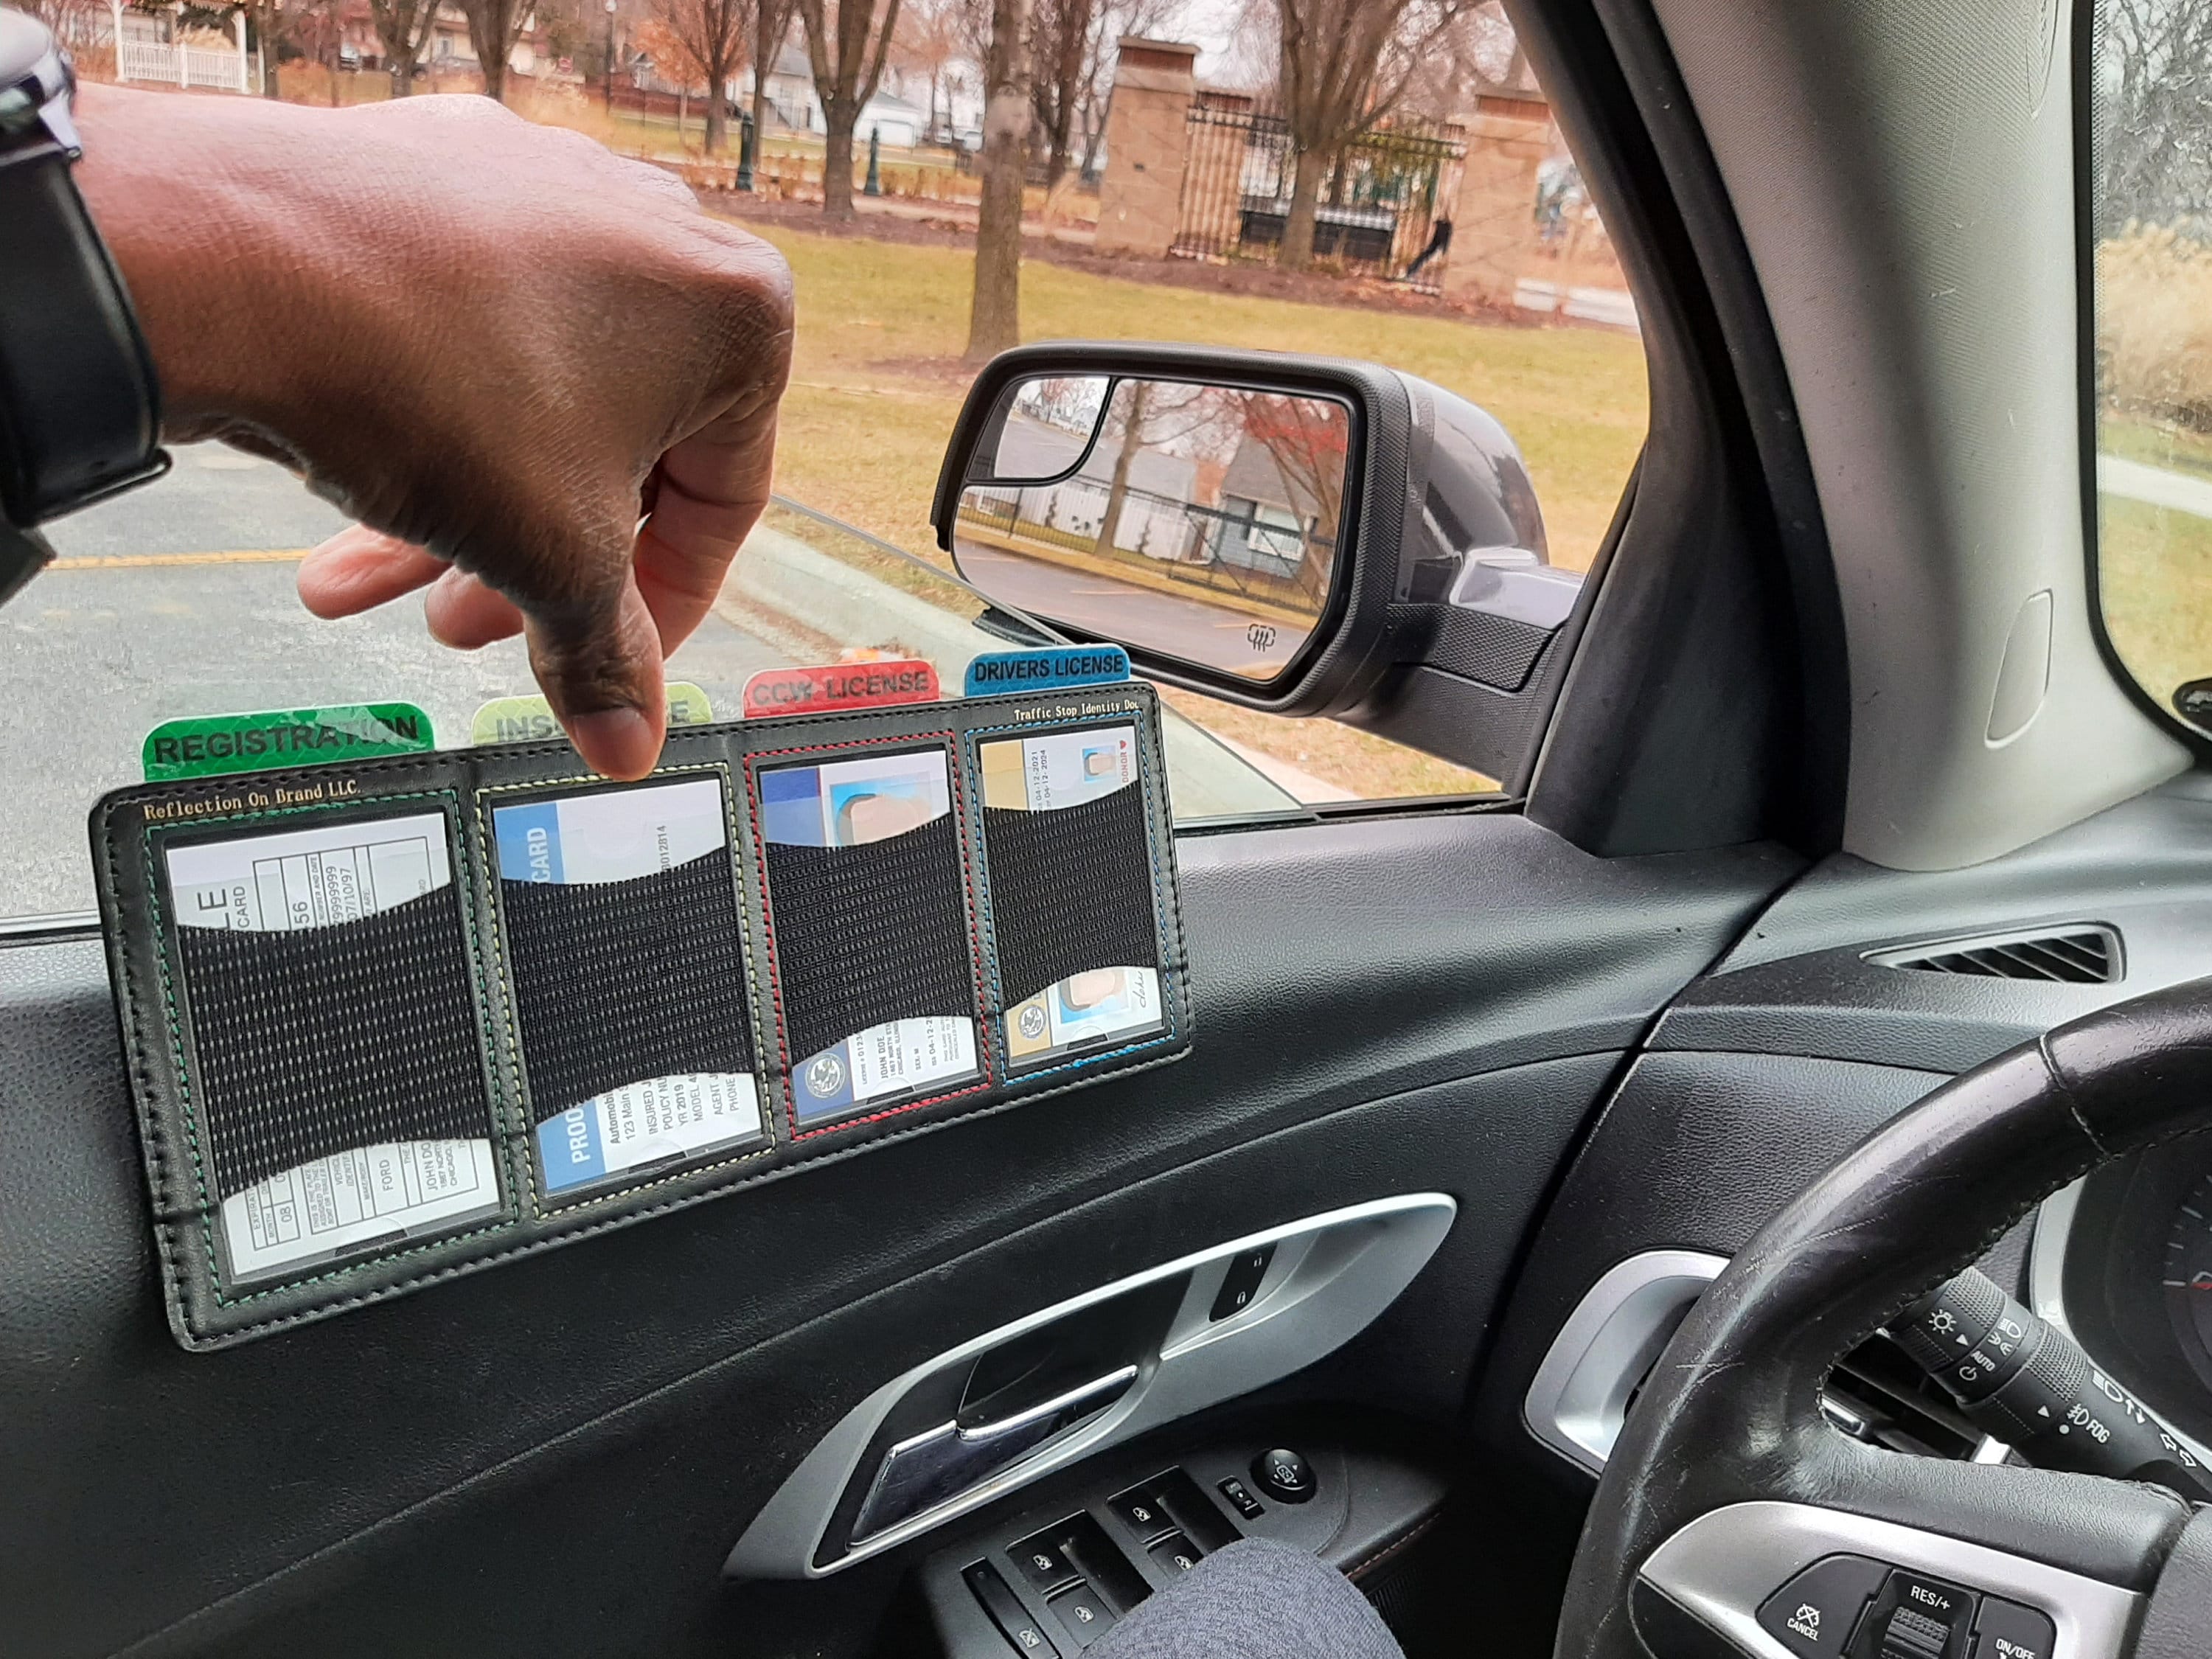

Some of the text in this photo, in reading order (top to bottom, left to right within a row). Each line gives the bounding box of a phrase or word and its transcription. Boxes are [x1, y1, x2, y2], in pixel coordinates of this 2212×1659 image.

[975, 654, 1124, 682] DRIVERS LICENSE
[754, 671, 929, 706] CCW LICENSE
[1014, 707, 1051, 721] Traffic
[1056, 705, 1077, 720] Stop
[1082, 700, 1120, 714] Identity
[144, 796, 243, 820] Reflection
[248, 792, 269, 807] On
[275, 783, 323, 804] Brand
[526, 827, 552, 884] CARD
[233, 886, 250, 928] CARD
[856, 1033, 865, 1057] 0123
[877, 1036, 888, 1079] JOHN DOE
[620, 1092, 633, 1118] Main
[675, 1084, 686, 1110] 2019
[690, 1088, 704, 1121] MODEL
[710, 1084, 723, 1115] AGENT
[726, 1077, 740, 1111] PHONE
[642, 1091, 658, 1135] INSURED
[661, 1094, 673, 1130] POLICY
[624, 1120, 636, 1140] 123
[379, 1158, 394, 1192] FORD
[424, 1158, 438, 1191] JOHN
[1970, 1350, 1996, 1371] AUTO
[2086, 1419, 2110, 1444] FOG
[1910, 1585, 1951, 1610] RES/+
[1787, 1618, 1819, 1641] CANCEL
[1996, 1638, 2037, 1659] ON/OFF
